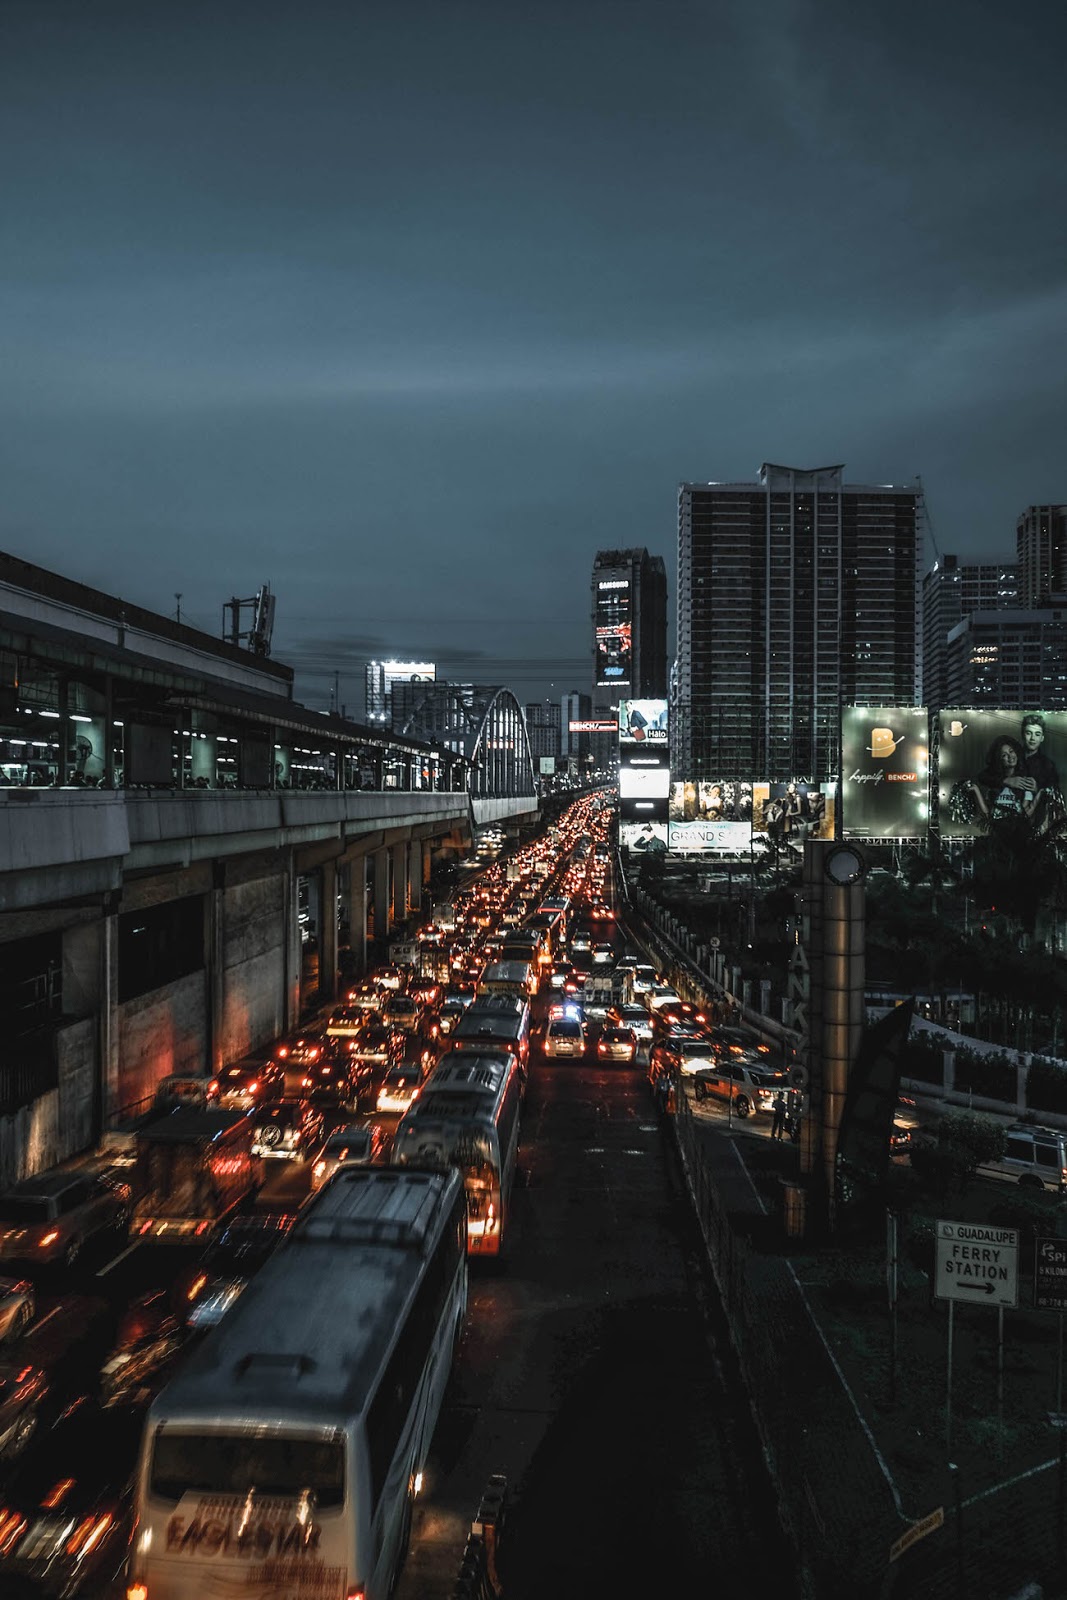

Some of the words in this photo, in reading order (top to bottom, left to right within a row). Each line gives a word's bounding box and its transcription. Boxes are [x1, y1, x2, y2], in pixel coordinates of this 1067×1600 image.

[649, 730, 666, 738] Halo
[957, 1226, 1015, 1244] GUADALUPE
[952, 1245, 1000, 1263] FERRY
[945, 1260, 1008, 1281] STATION
